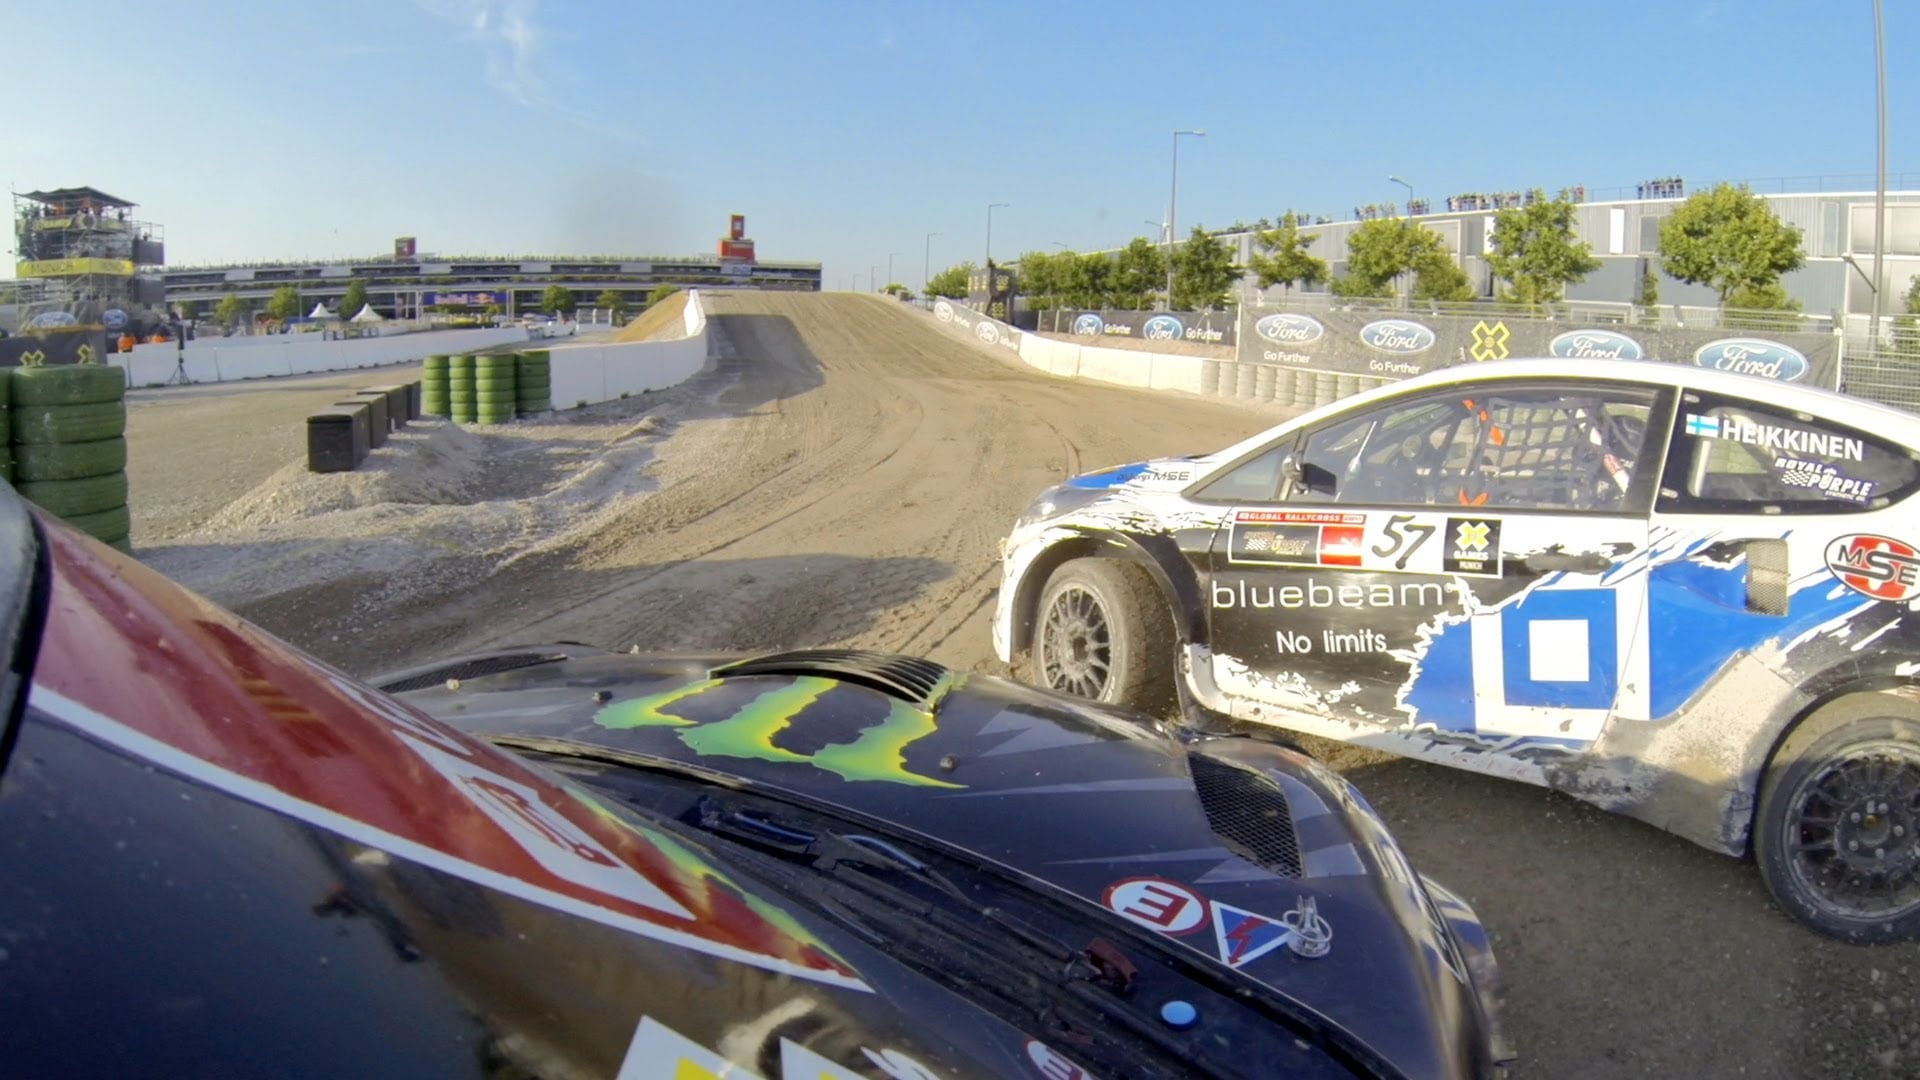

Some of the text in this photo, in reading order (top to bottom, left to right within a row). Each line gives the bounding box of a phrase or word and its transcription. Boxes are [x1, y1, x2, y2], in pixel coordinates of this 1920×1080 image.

[1186, 327, 1223, 341] Go Further
[1266, 317, 1311, 341] Ford
[1372, 324, 1420, 350] Ford
[1263, 350, 1311, 364] Go Further
[1369, 359, 1421, 375] Go Further
[1720, 342, 1785, 380] Ford
[1722, 419, 1864, 462] HEIKKINEN
[1153, 471, 1190, 481] MSE
[1775, 457, 1824, 474] ROYAL
[1807, 473, 1873, 498] PURPLE
[1249, 512, 1282, 521] GLOBAL
[1285, 513, 1341, 522] RALLYCROSS
[1371, 514, 1437, 570] 57
[1453, 550, 1489, 561] GAMES
[1831, 543, 1920, 588] MSE
[1212, 578, 1443, 608] bluebeam
[1276, 628, 1388, 653] No limits
